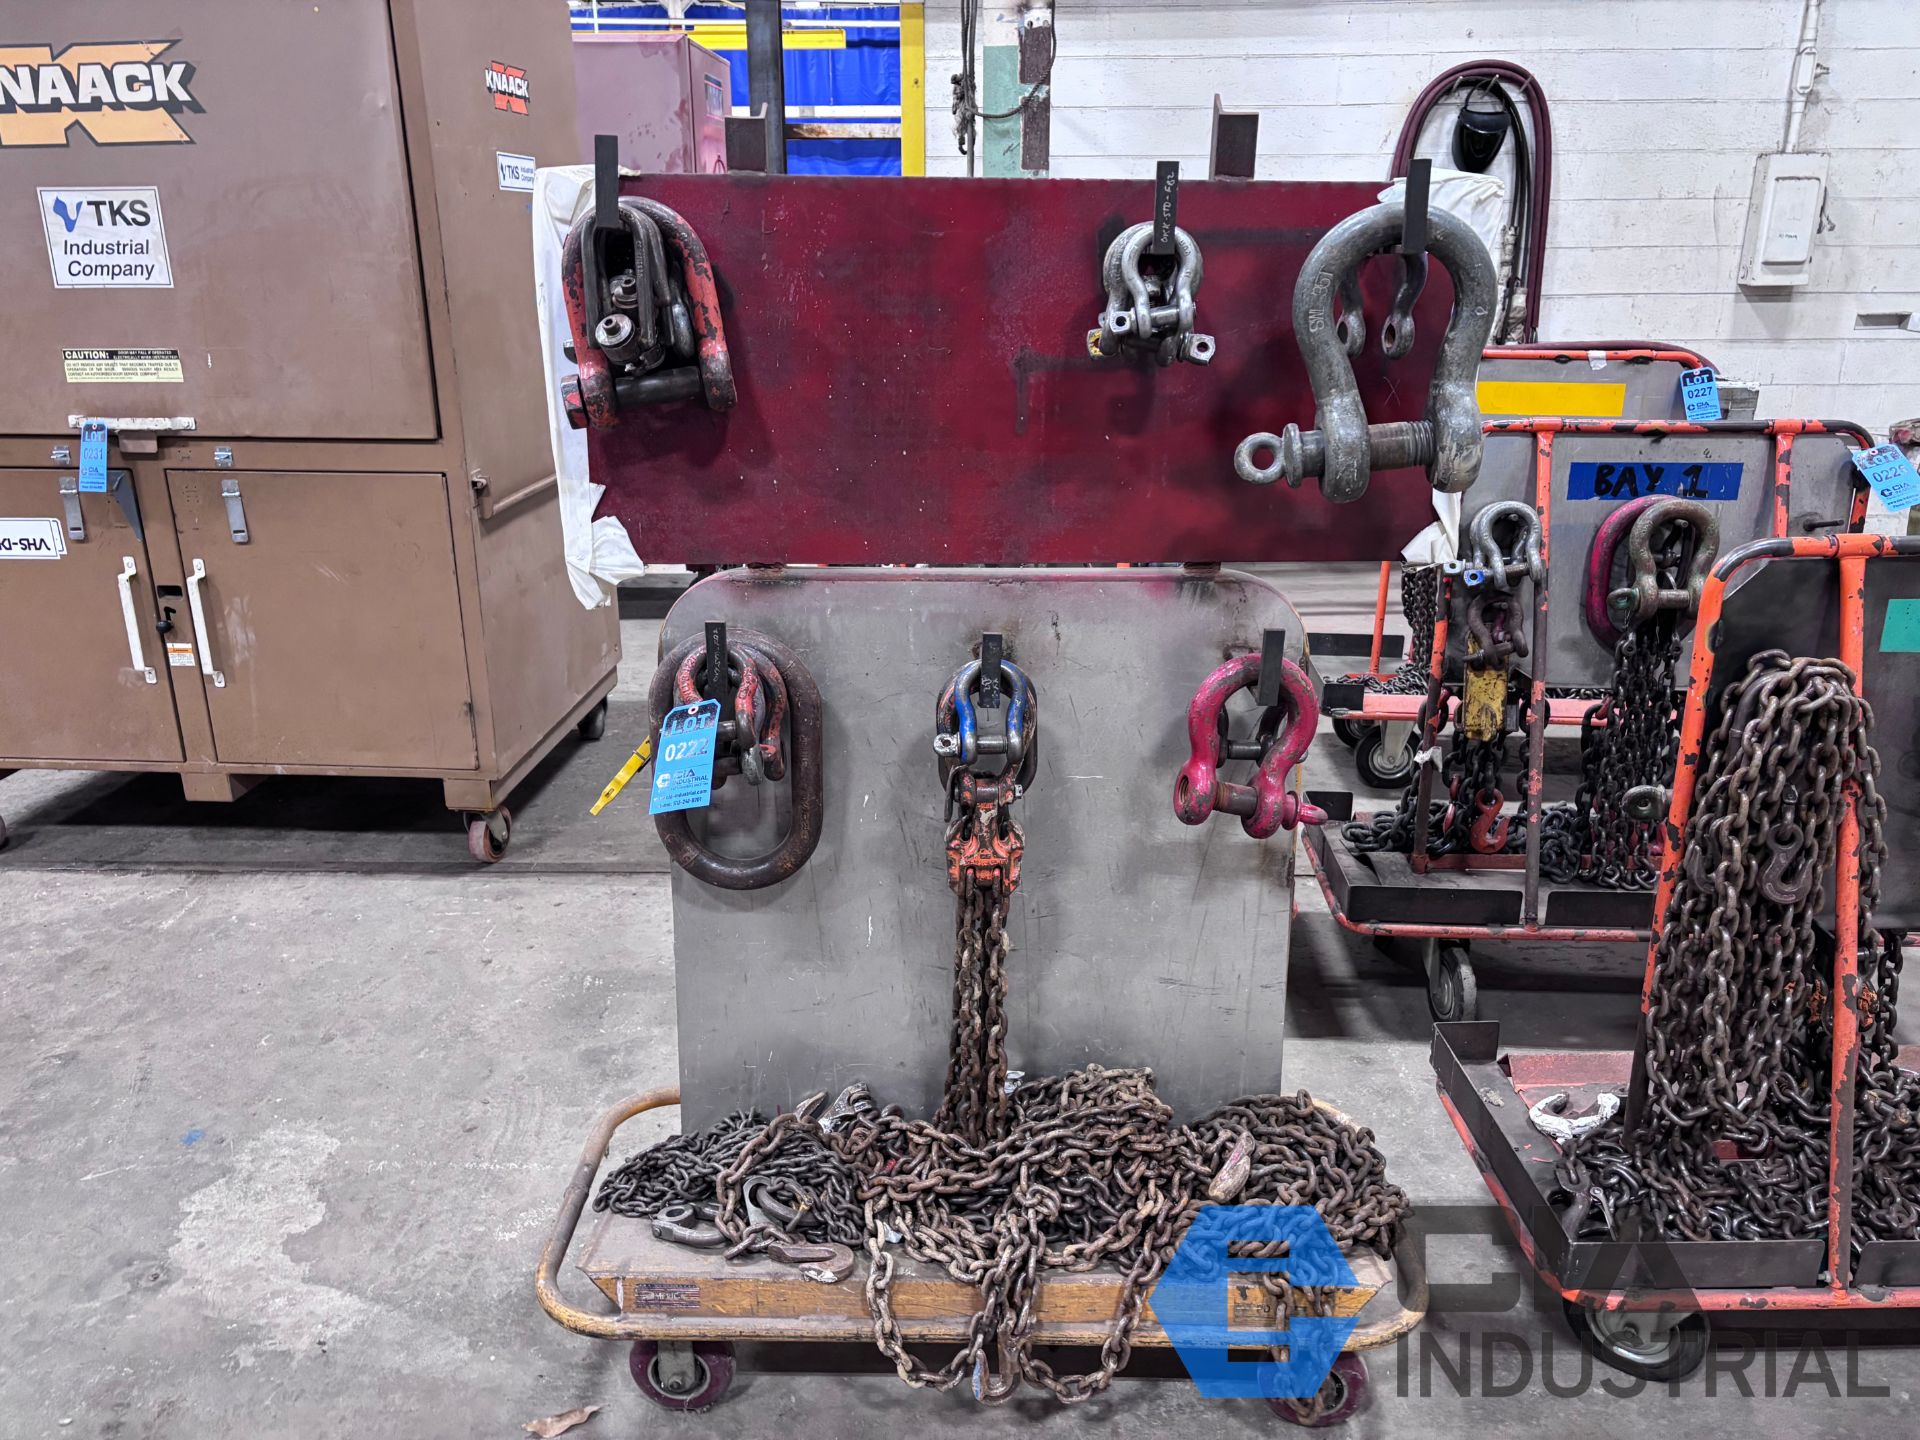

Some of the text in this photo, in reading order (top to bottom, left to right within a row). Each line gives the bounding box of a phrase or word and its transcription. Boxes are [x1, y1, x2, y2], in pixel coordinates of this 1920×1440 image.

[485, 69, 529, 98] KNAACK
[506, 165, 520, 180] TKS
[86, 199, 152, 227] TKS
[64, 239, 150, 256] Industrial
[67, 260, 155, 281] Company
[65, 350, 110, 360] CAUTION:
[1685, 374, 1710, 386] LOT
[1687, 386, 1713, 399] 0227
[86, 430, 105, 441] LOT
[1861, 452, 1893, 469] LOT
[1594, 463, 1665, 498] BAY
[670, 712, 711, 735] LOT
[664, 737, 709, 762] 0222
